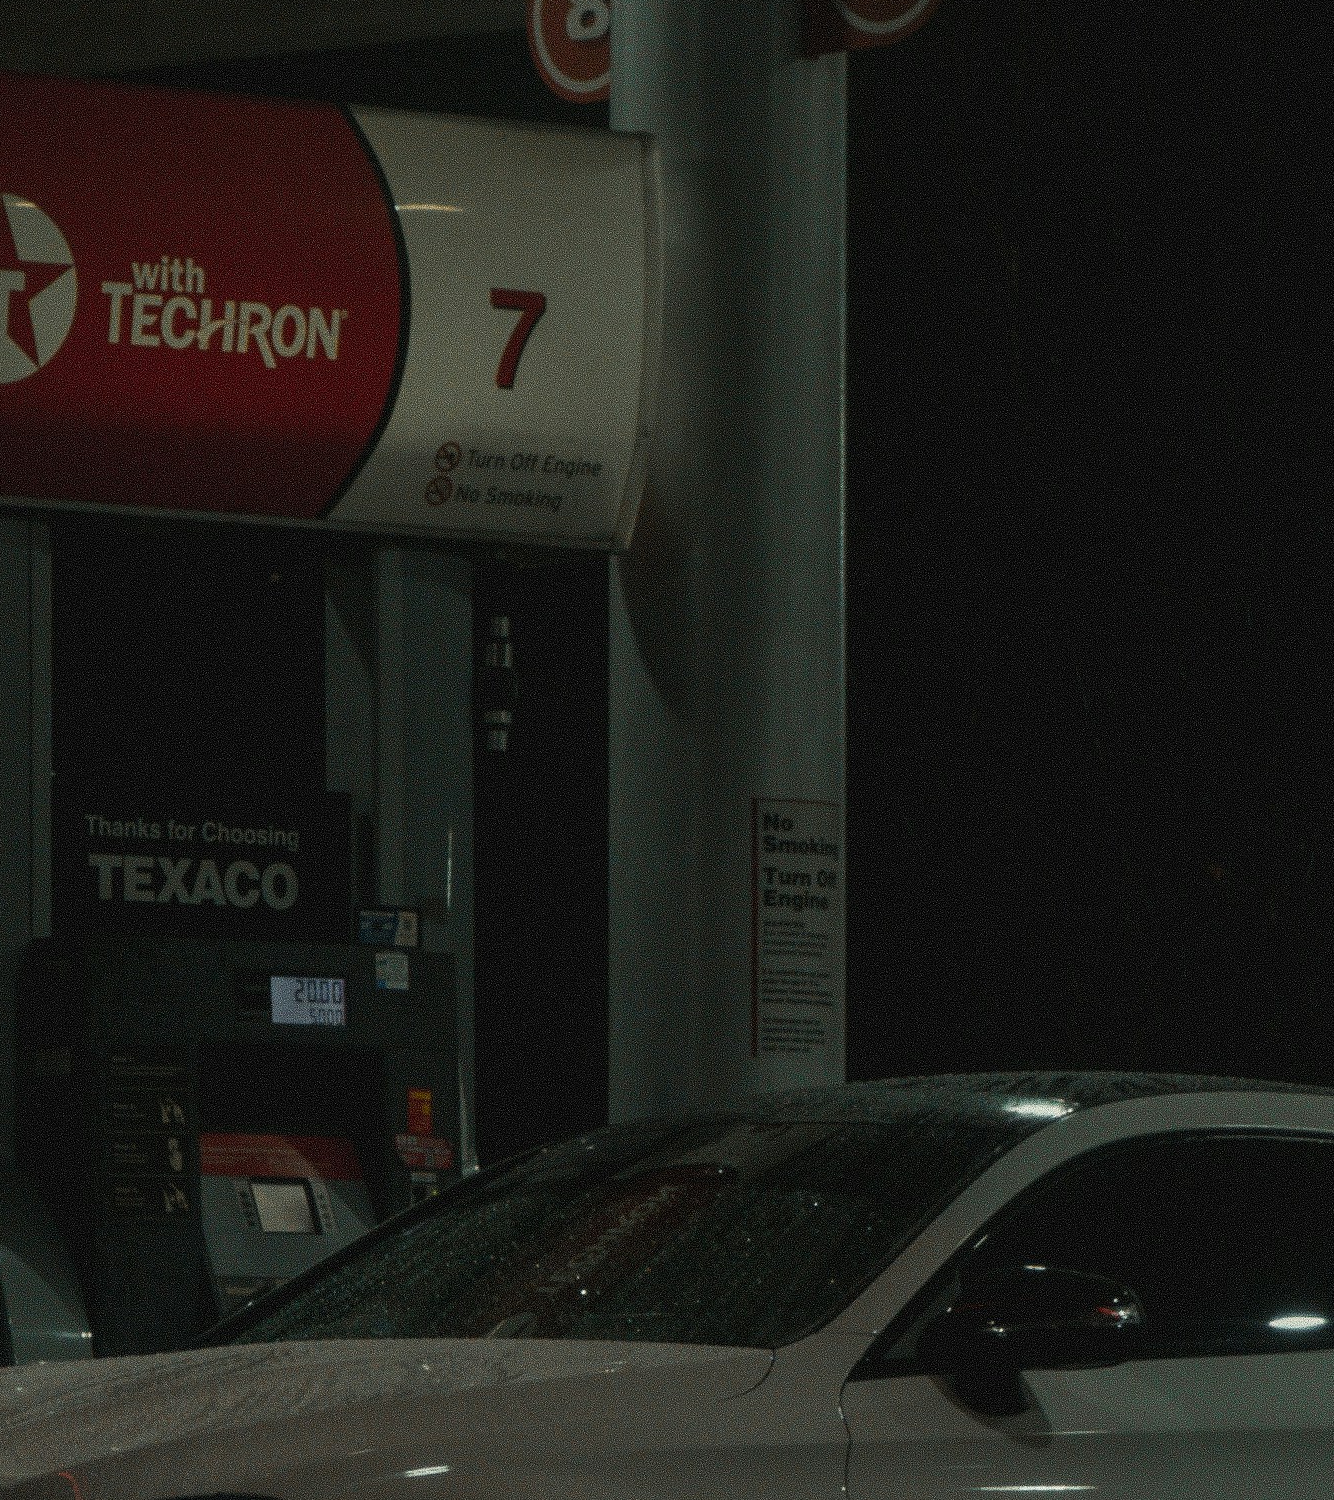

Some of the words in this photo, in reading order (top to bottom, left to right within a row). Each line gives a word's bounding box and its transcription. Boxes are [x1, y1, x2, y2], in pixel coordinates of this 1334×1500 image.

[132, 255, 206, 294] with
[101, 280, 342, 370] TECHRON
[489, 287, 547, 390] 7
[468, 450, 506, 470] Turn
[510, 452, 538, 472] Off
[542, 455, 603, 479] Engine
[455, 483, 481, 503] No
[487, 485, 563, 513] Smoking
[84, 813, 162, 840] Thanks
[167, 819, 197, 841] for
[202, 820, 300, 852] Choosing
[763, 812, 793, 831] No
[763, 835, 839, 861] Smoking
[87, 852, 300, 911] TEXACO
[762, 866, 812, 886] Turn
[763, 889, 829, 912] Engine
